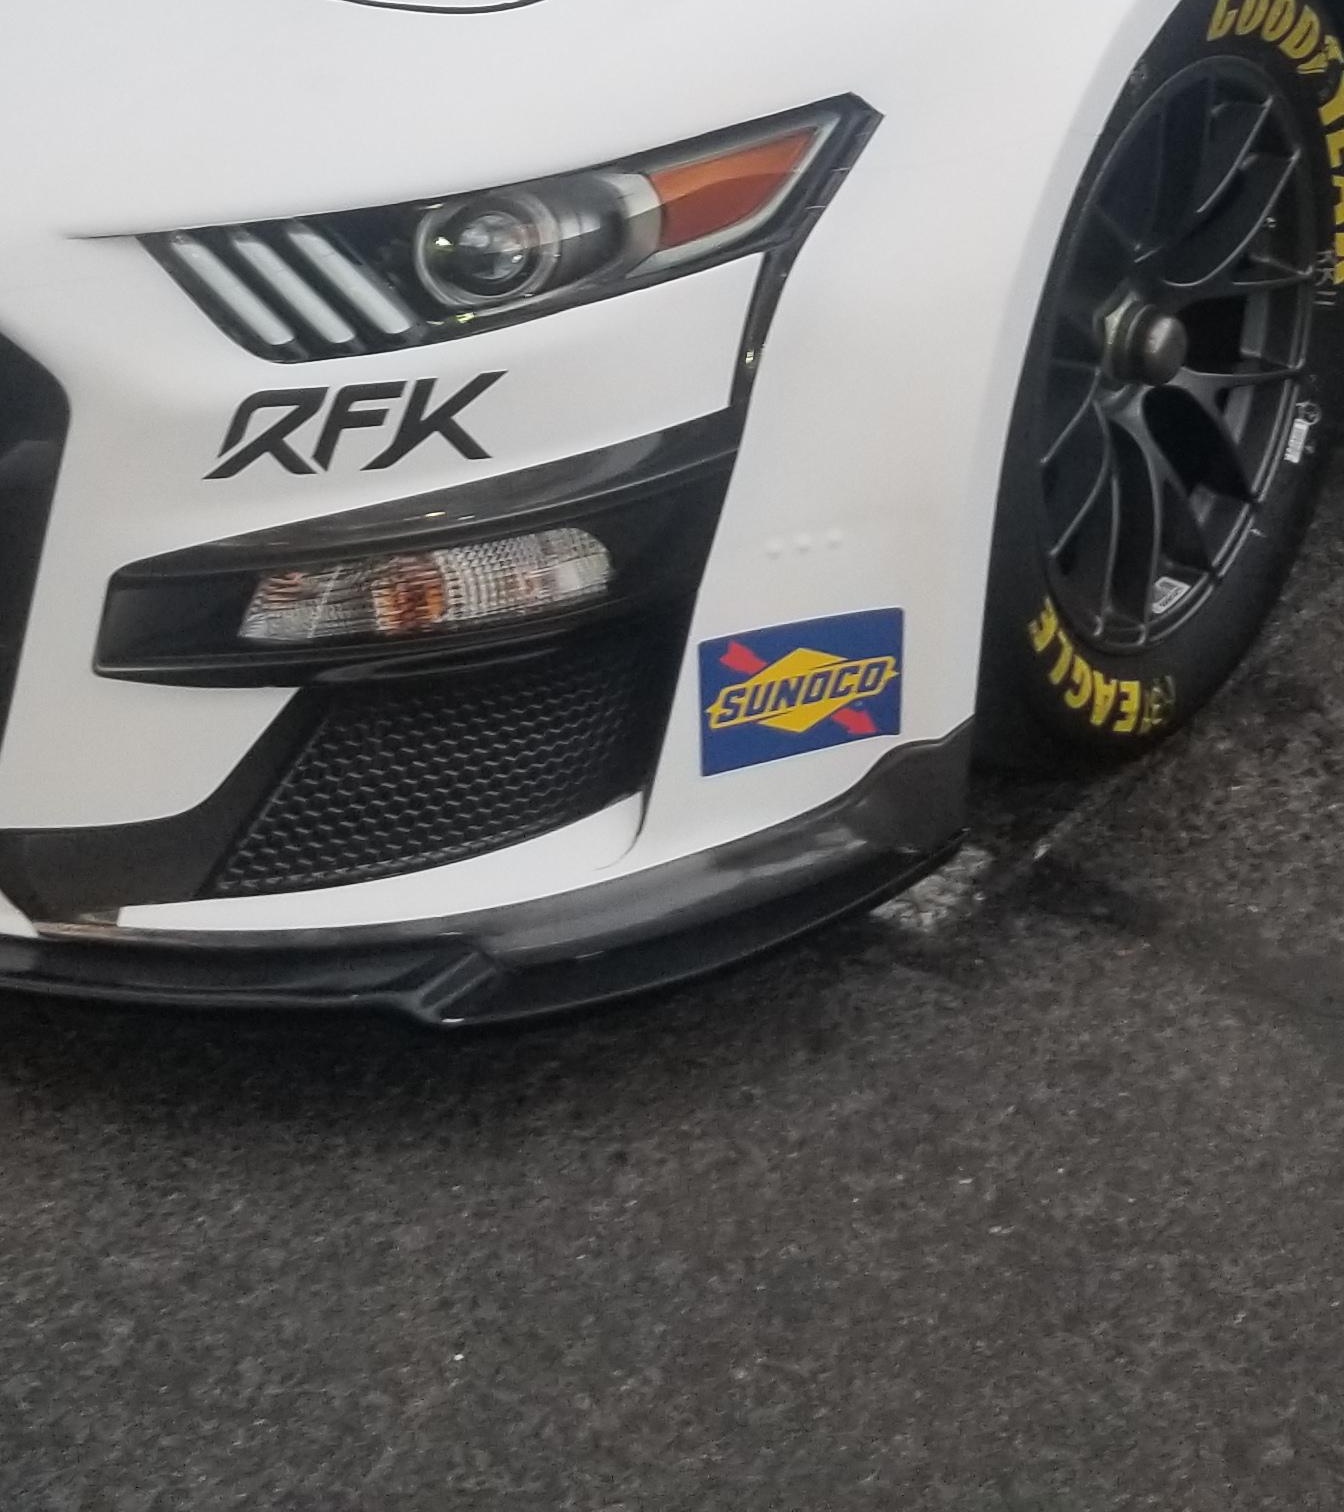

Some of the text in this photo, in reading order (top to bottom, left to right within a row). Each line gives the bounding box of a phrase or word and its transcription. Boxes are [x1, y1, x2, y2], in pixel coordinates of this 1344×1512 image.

[202, 370, 508, 481] RFK
[716, 660, 890, 725] SUNOCO
[1027, 596, 1141, 734] EAGLE
